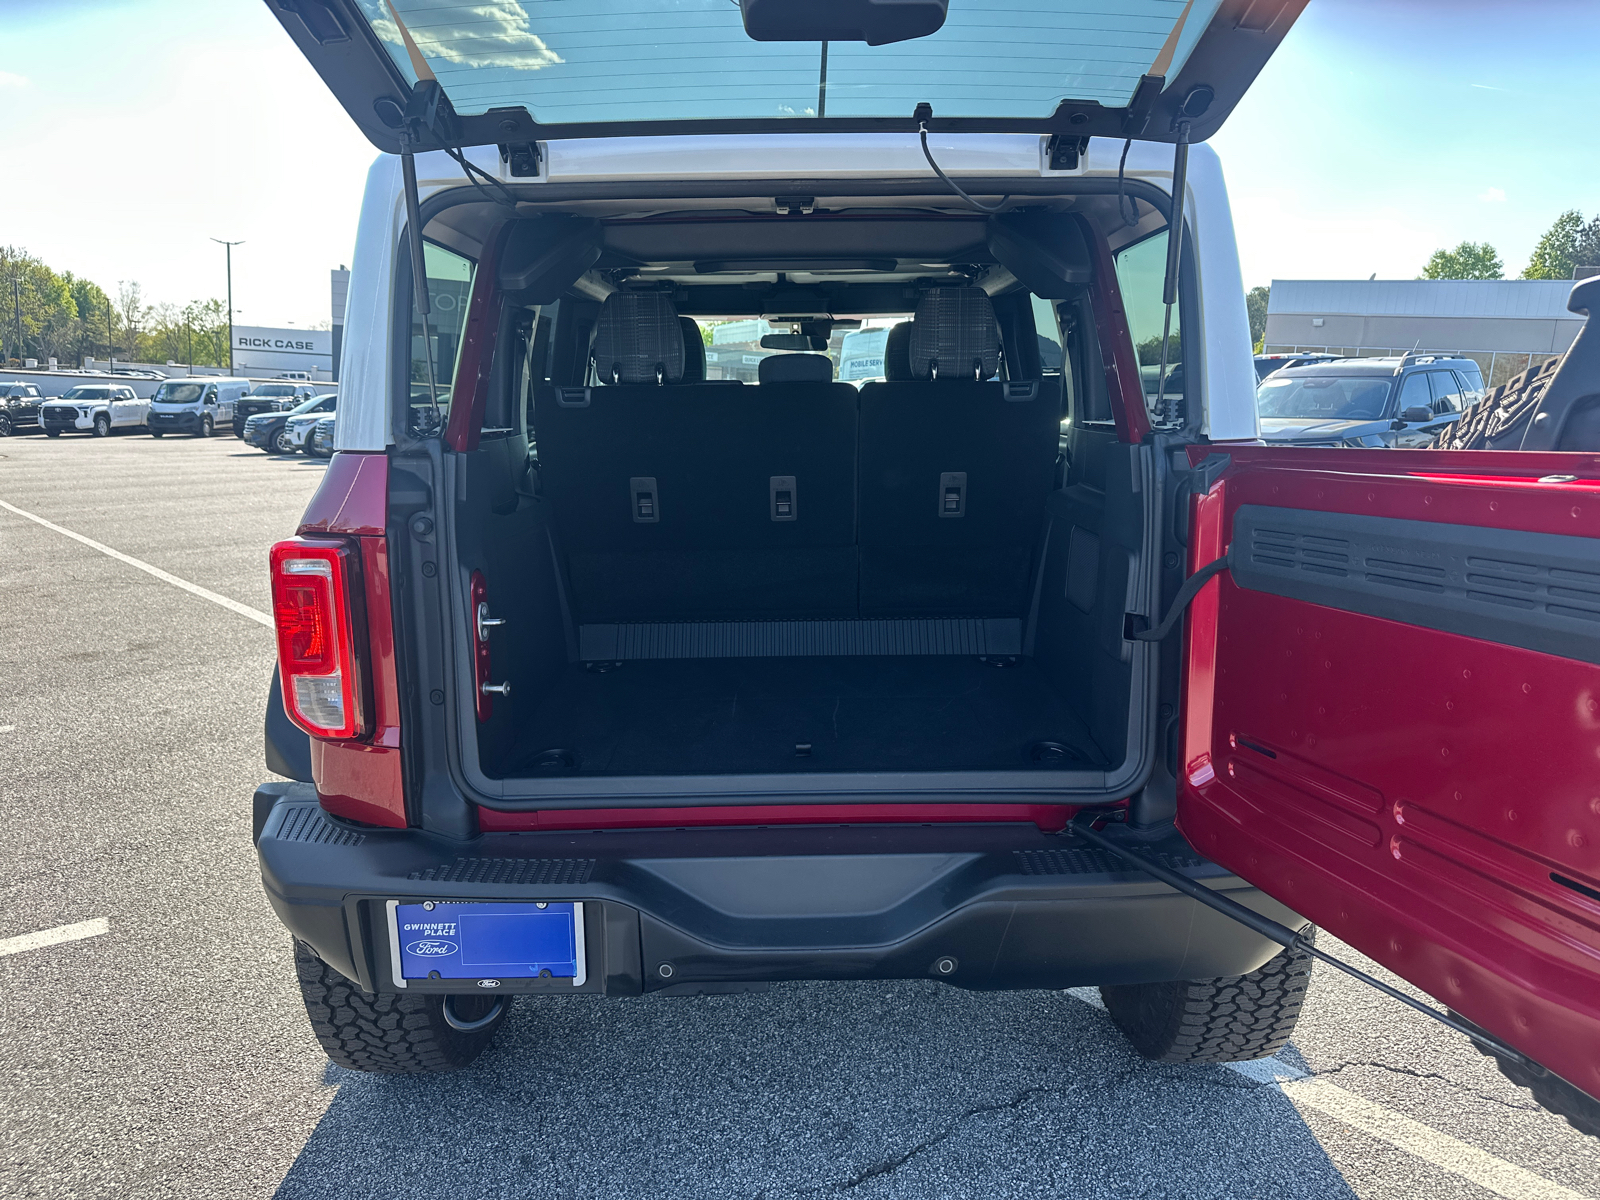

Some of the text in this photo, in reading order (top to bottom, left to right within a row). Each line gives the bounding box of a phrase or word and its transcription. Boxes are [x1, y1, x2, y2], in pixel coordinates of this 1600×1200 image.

[239, 337, 314, 350] RICK CASE
[850, 360, 868, 368] MOBILE
[404, 923, 456, 931] GWINNETT
[416, 941, 448, 954] Ford
